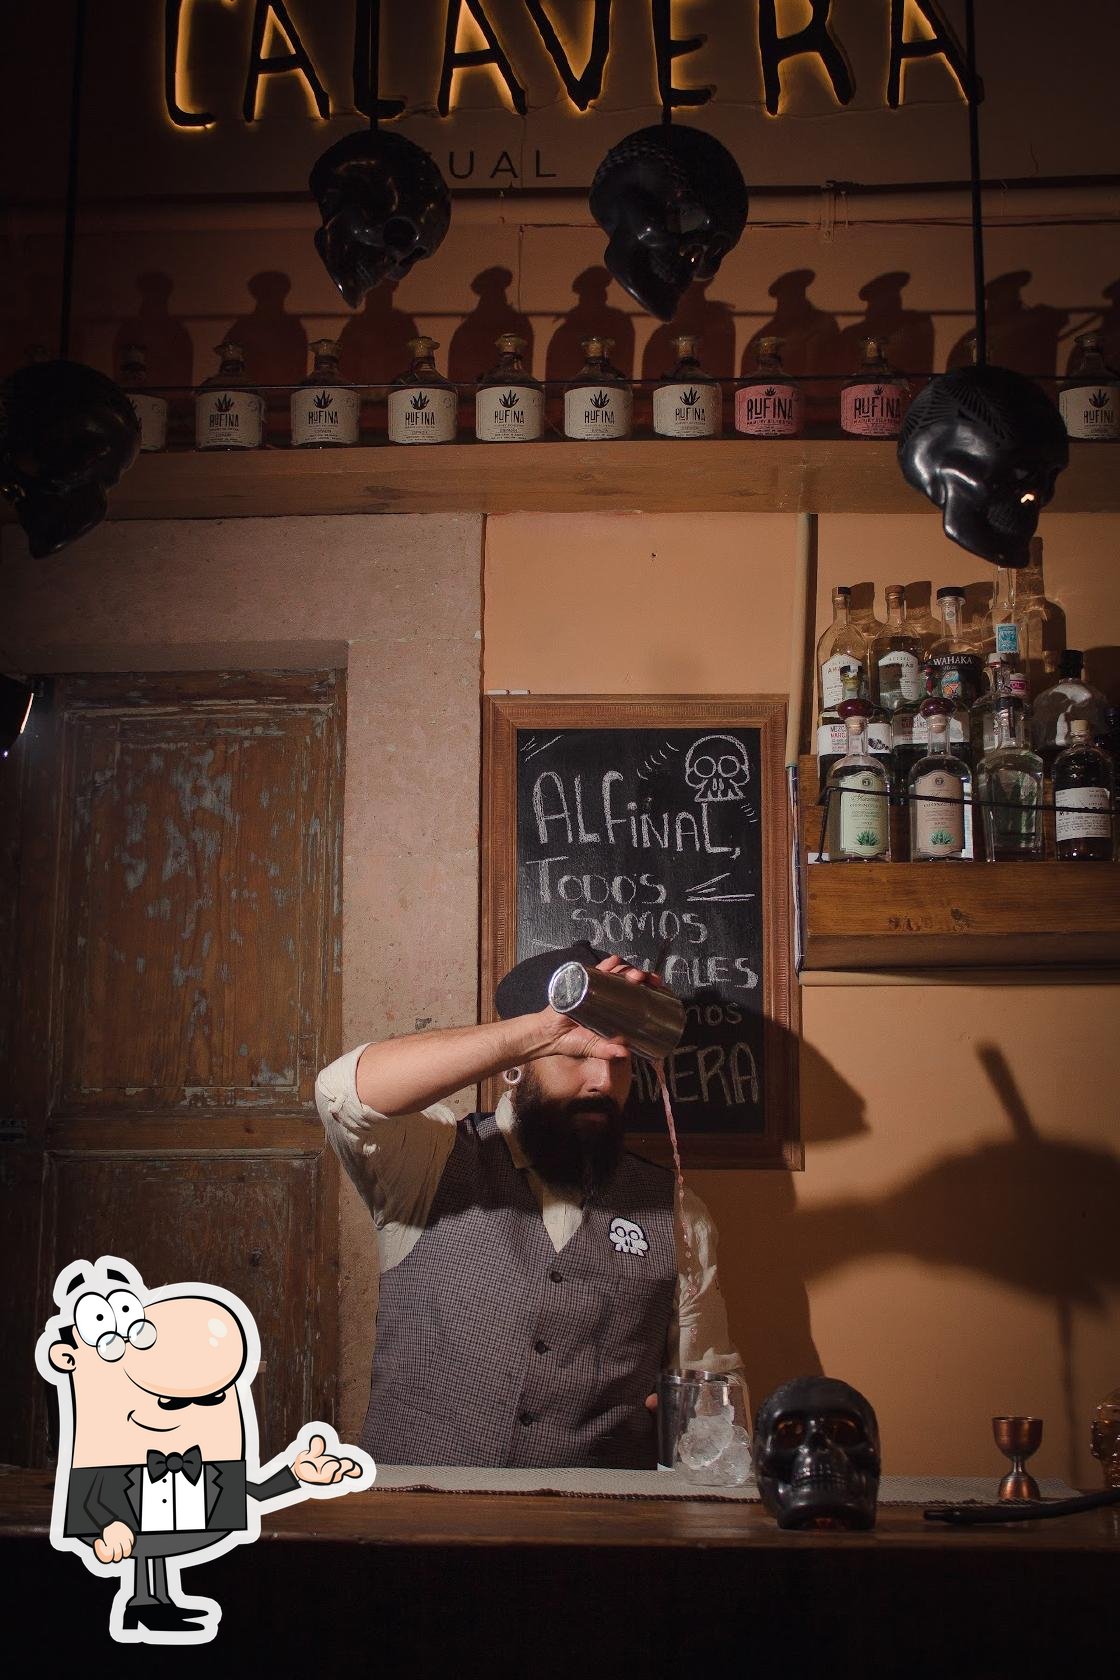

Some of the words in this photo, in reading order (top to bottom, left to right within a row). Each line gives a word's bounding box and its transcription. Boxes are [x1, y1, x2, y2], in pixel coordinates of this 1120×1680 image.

[163, 0, 984, 128] CALAVERA
[675, 407, 706, 422] RUFINA
[747, 397, 793, 420] RUFINA
[209, 413, 239, 427] RUFINA
[308, 410, 338, 424] RUFINA
[405, 411, 436, 426] RUFINA
[494, 409, 525, 424] RUFINA
[584, 410, 615, 425] RUFINA
[933, 655, 974, 667] WAHAKA
[525, 855, 667, 904] TODOS
[569, 907, 708, 946] SOMOS
